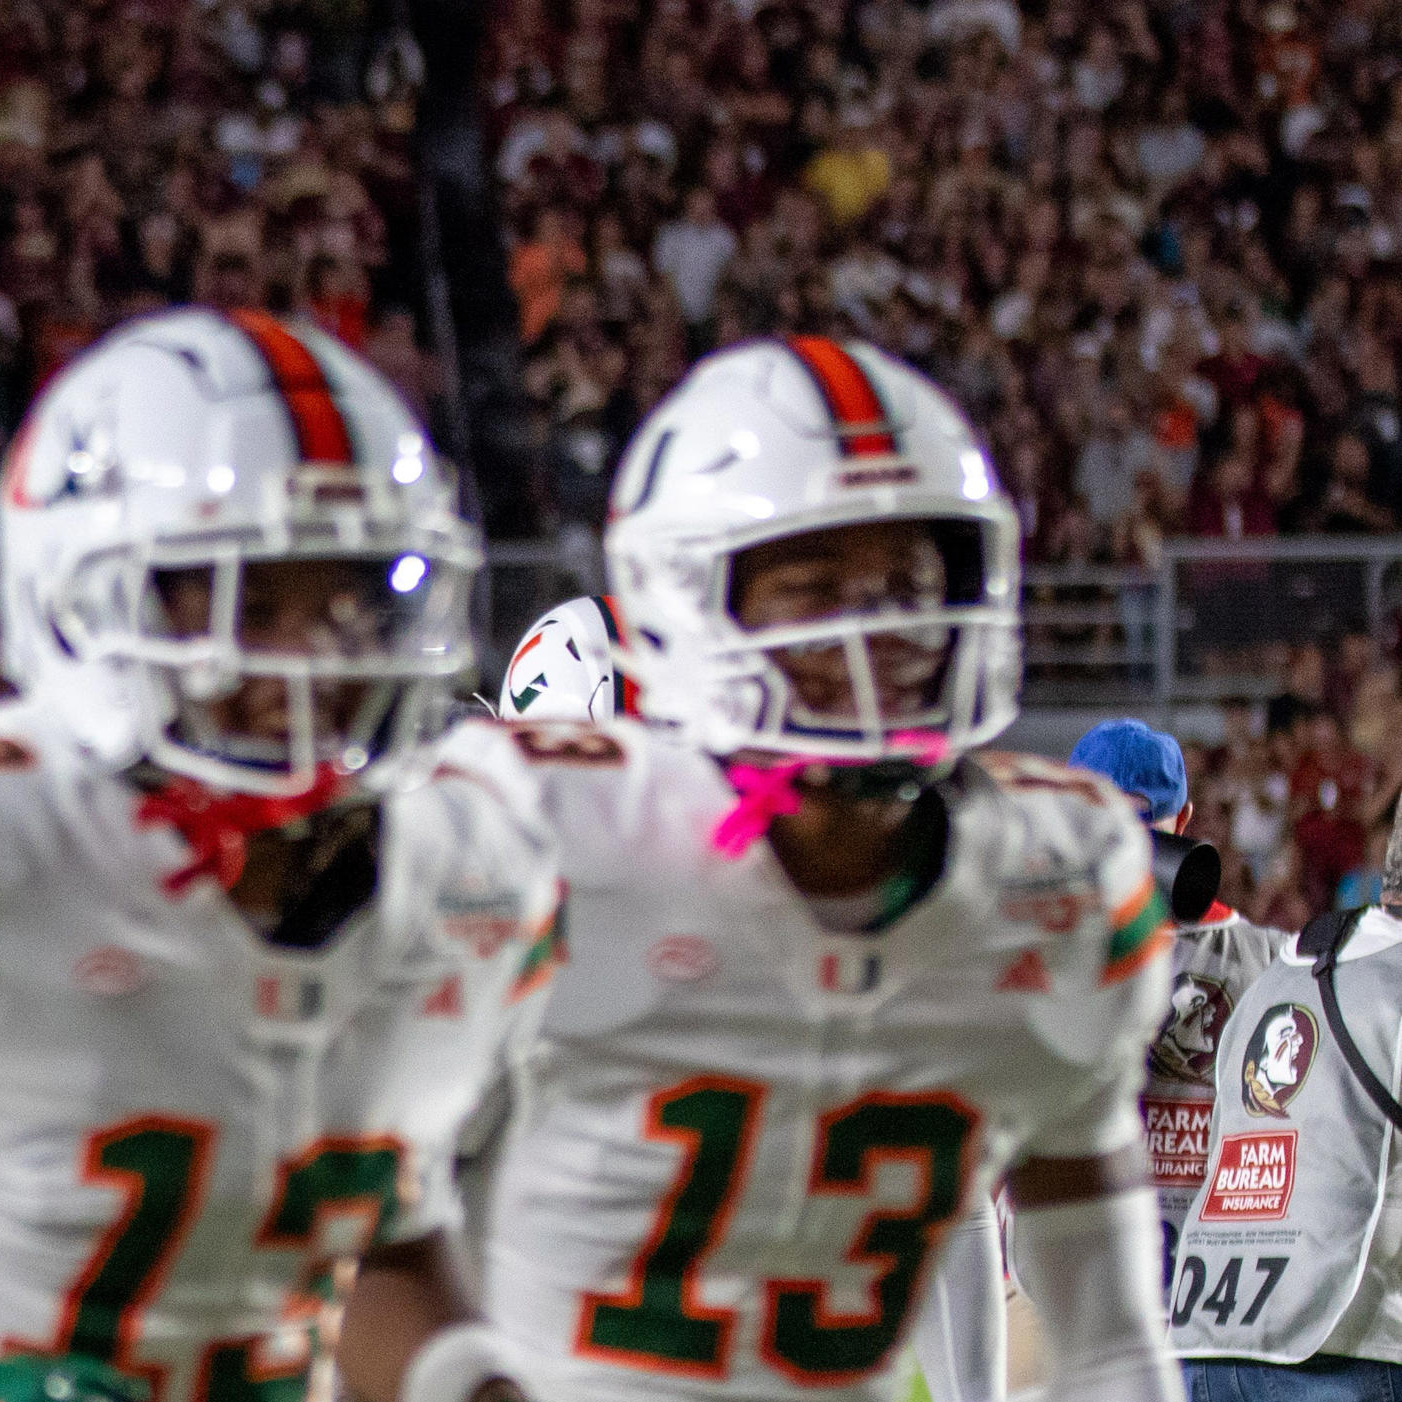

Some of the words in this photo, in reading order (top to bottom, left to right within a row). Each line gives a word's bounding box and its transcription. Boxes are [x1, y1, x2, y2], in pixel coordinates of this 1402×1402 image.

[1240, 1142, 1286, 1168] FARM
[1216, 1167, 1286, 1191] BUREAU
[1222, 1196, 1281, 1211] INSURANCE
[572, 1072, 982, 1388] 13
[1171, 1255, 1291, 1328] 047
